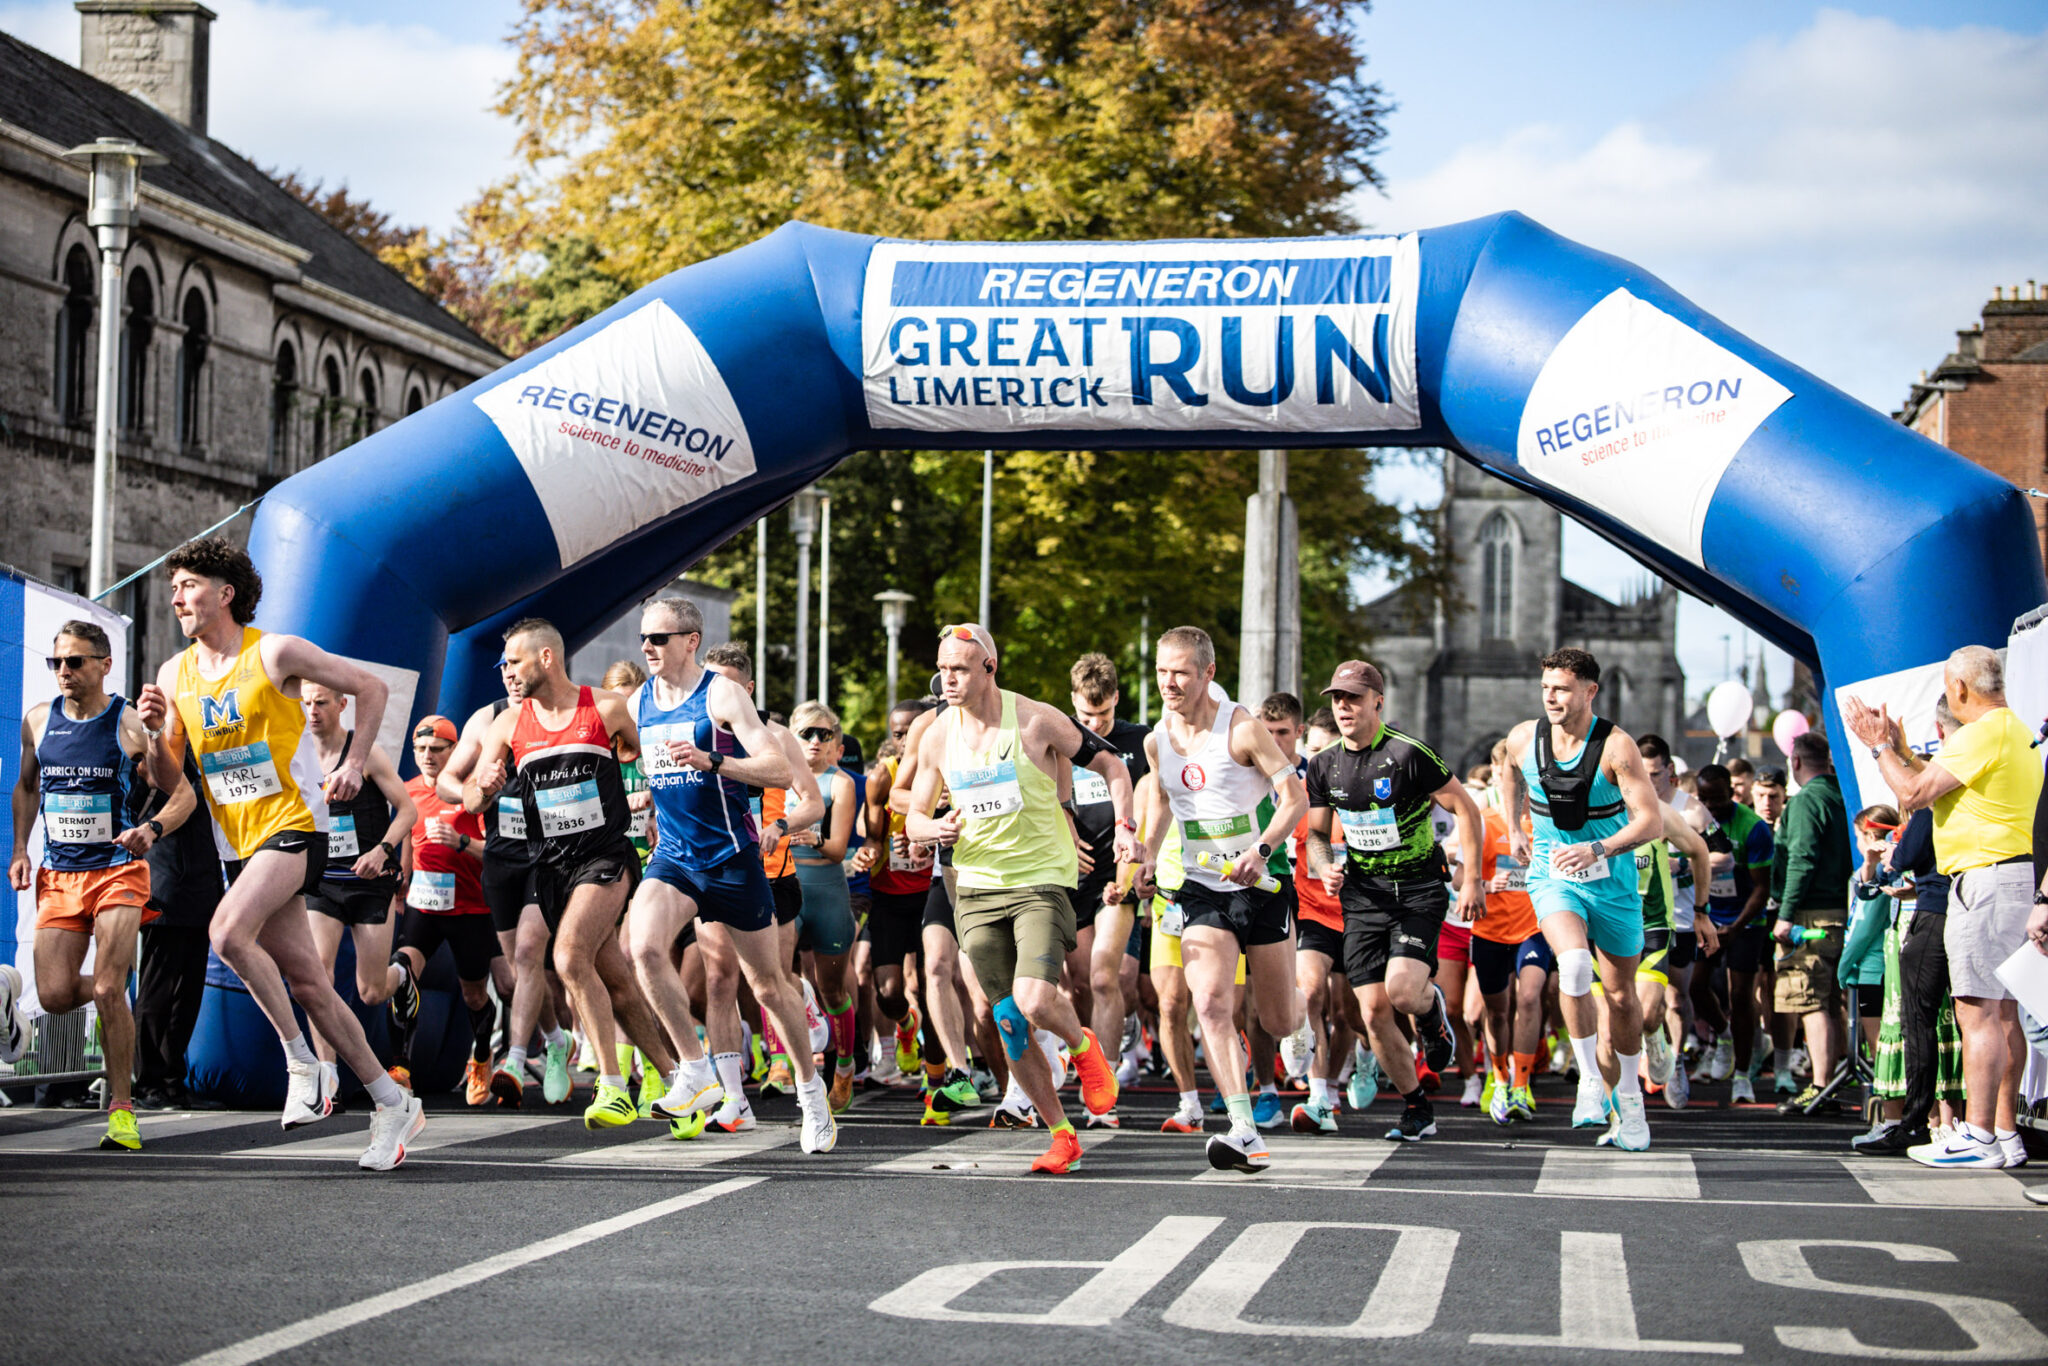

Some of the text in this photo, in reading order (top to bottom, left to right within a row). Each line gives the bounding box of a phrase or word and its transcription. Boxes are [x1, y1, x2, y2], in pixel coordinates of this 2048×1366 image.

[978, 265, 1299, 300] REGENERON
[888, 316, 1107, 368] GREAT
[1121, 312, 1395, 408] RUN
[888, 375, 1108, 408] LIMERICK
[517, 384, 735, 462] REGENERON
[1536, 378, 1741, 456] REGENERON
[1580, 408, 1726, 466] science to mcine
[558, 420, 706, 477] science to medicine
[199, 687, 243, 730] M
[203, 722, 247, 739] COWBOYS
[44, 766, 114, 778] CARRICK ON SUIR
[222, 767, 261, 786] KARL
[550, 767, 569, 780] Brú
[570, 763, 593, 777] A.C.
[685, 770, 703, 784] AC
[229, 783, 257, 797] 1975
[972, 800, 1001, 814] 2176
[58, 816, 97, 825] DERMOT
[510, 816, 526, 824] PIA
[556, 817, 586, 831] 2836
[62, 829, 90, 839] 1357
[1350, 828, 1388, 836] MATTHEW
[1358, 838, 1382, 847] 1236
[866, 1214, 2046, 1361] STOP
